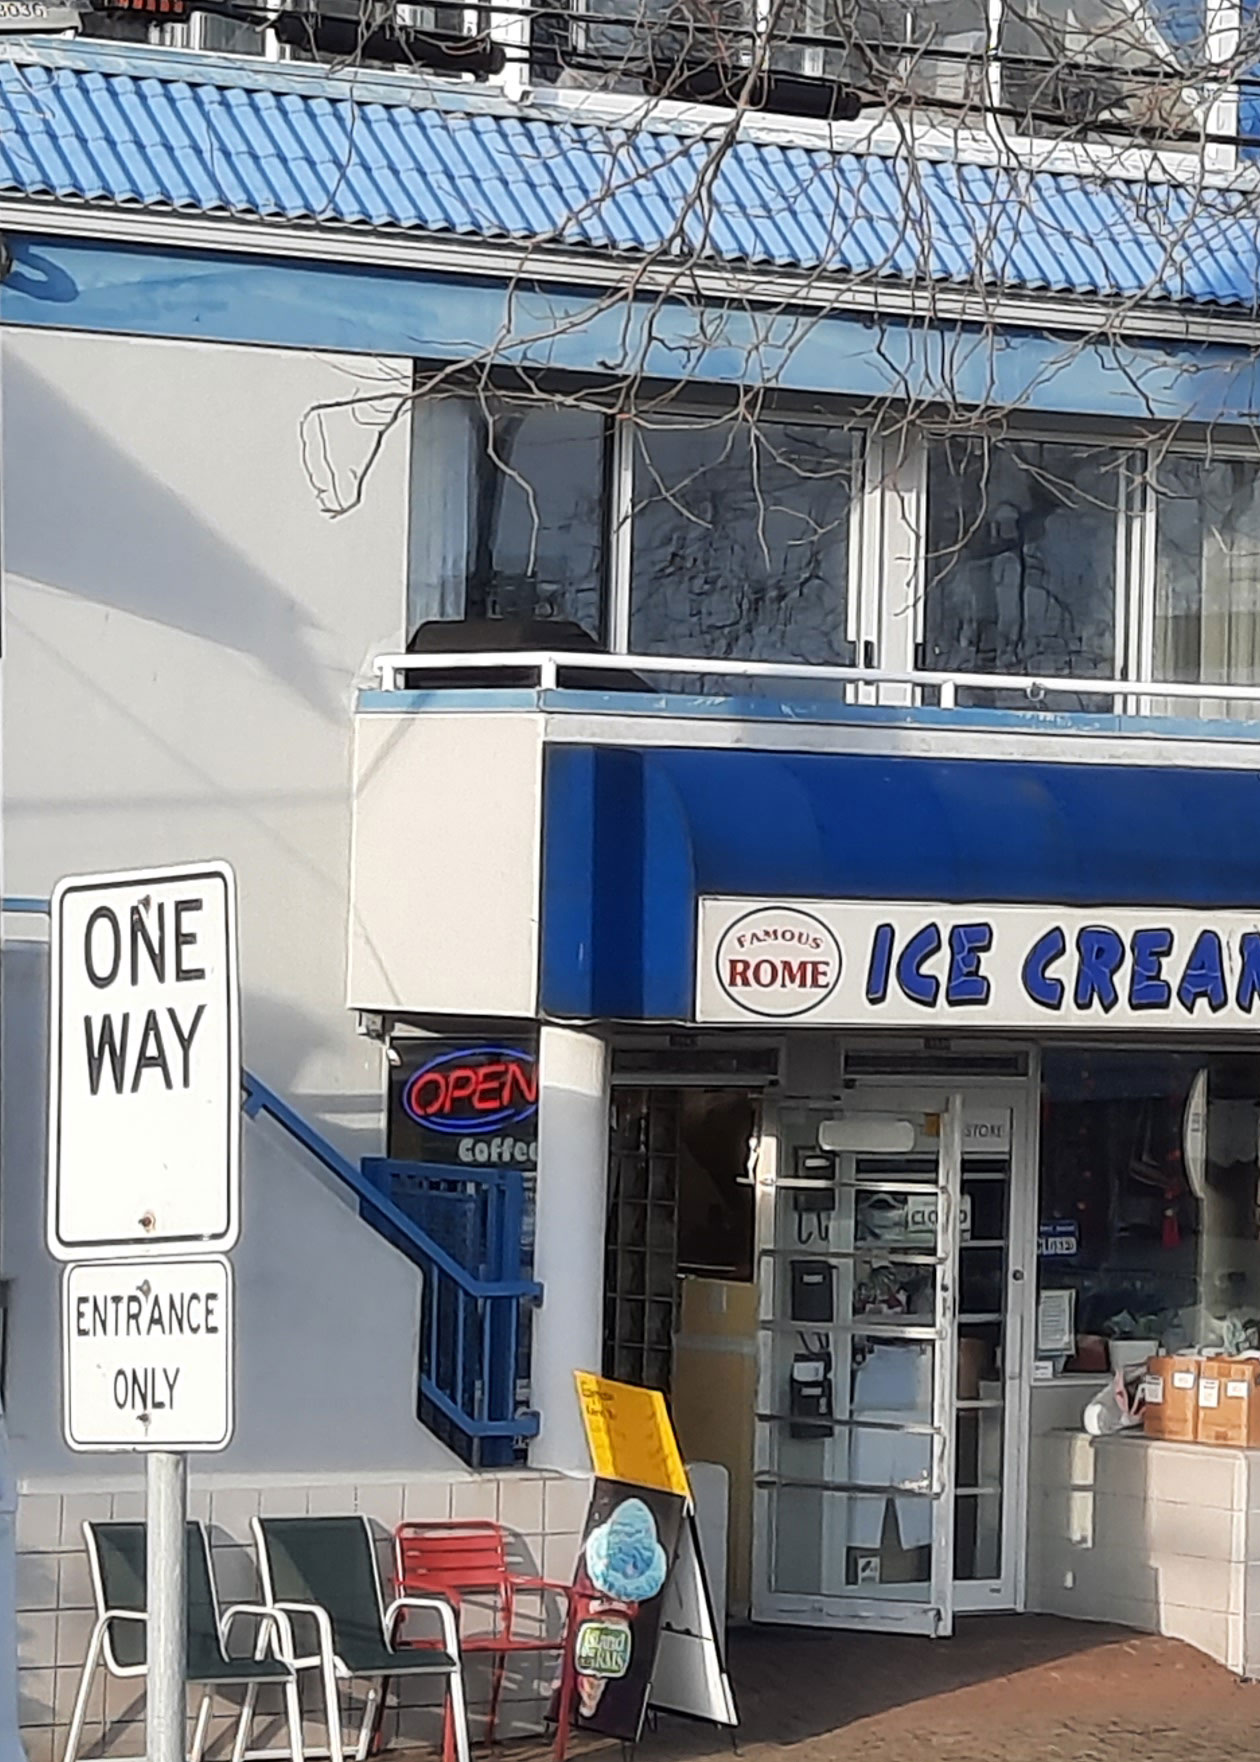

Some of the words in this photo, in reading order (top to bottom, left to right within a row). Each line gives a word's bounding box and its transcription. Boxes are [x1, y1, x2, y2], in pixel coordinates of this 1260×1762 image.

[84, 898, 206, 989] ONE
[736, 928, 824, 950] FAMOUS
[728, 958, 830, 989] ROME
[866, 922, 994, 1008] ICE
[84, 1004, 208, 1096] WAY
[411, 1061, 538, 1116] OPEN
[77, 1292, 219, 1337] ENTRANCE
[114, 1367, 180, 1411] ONLY
